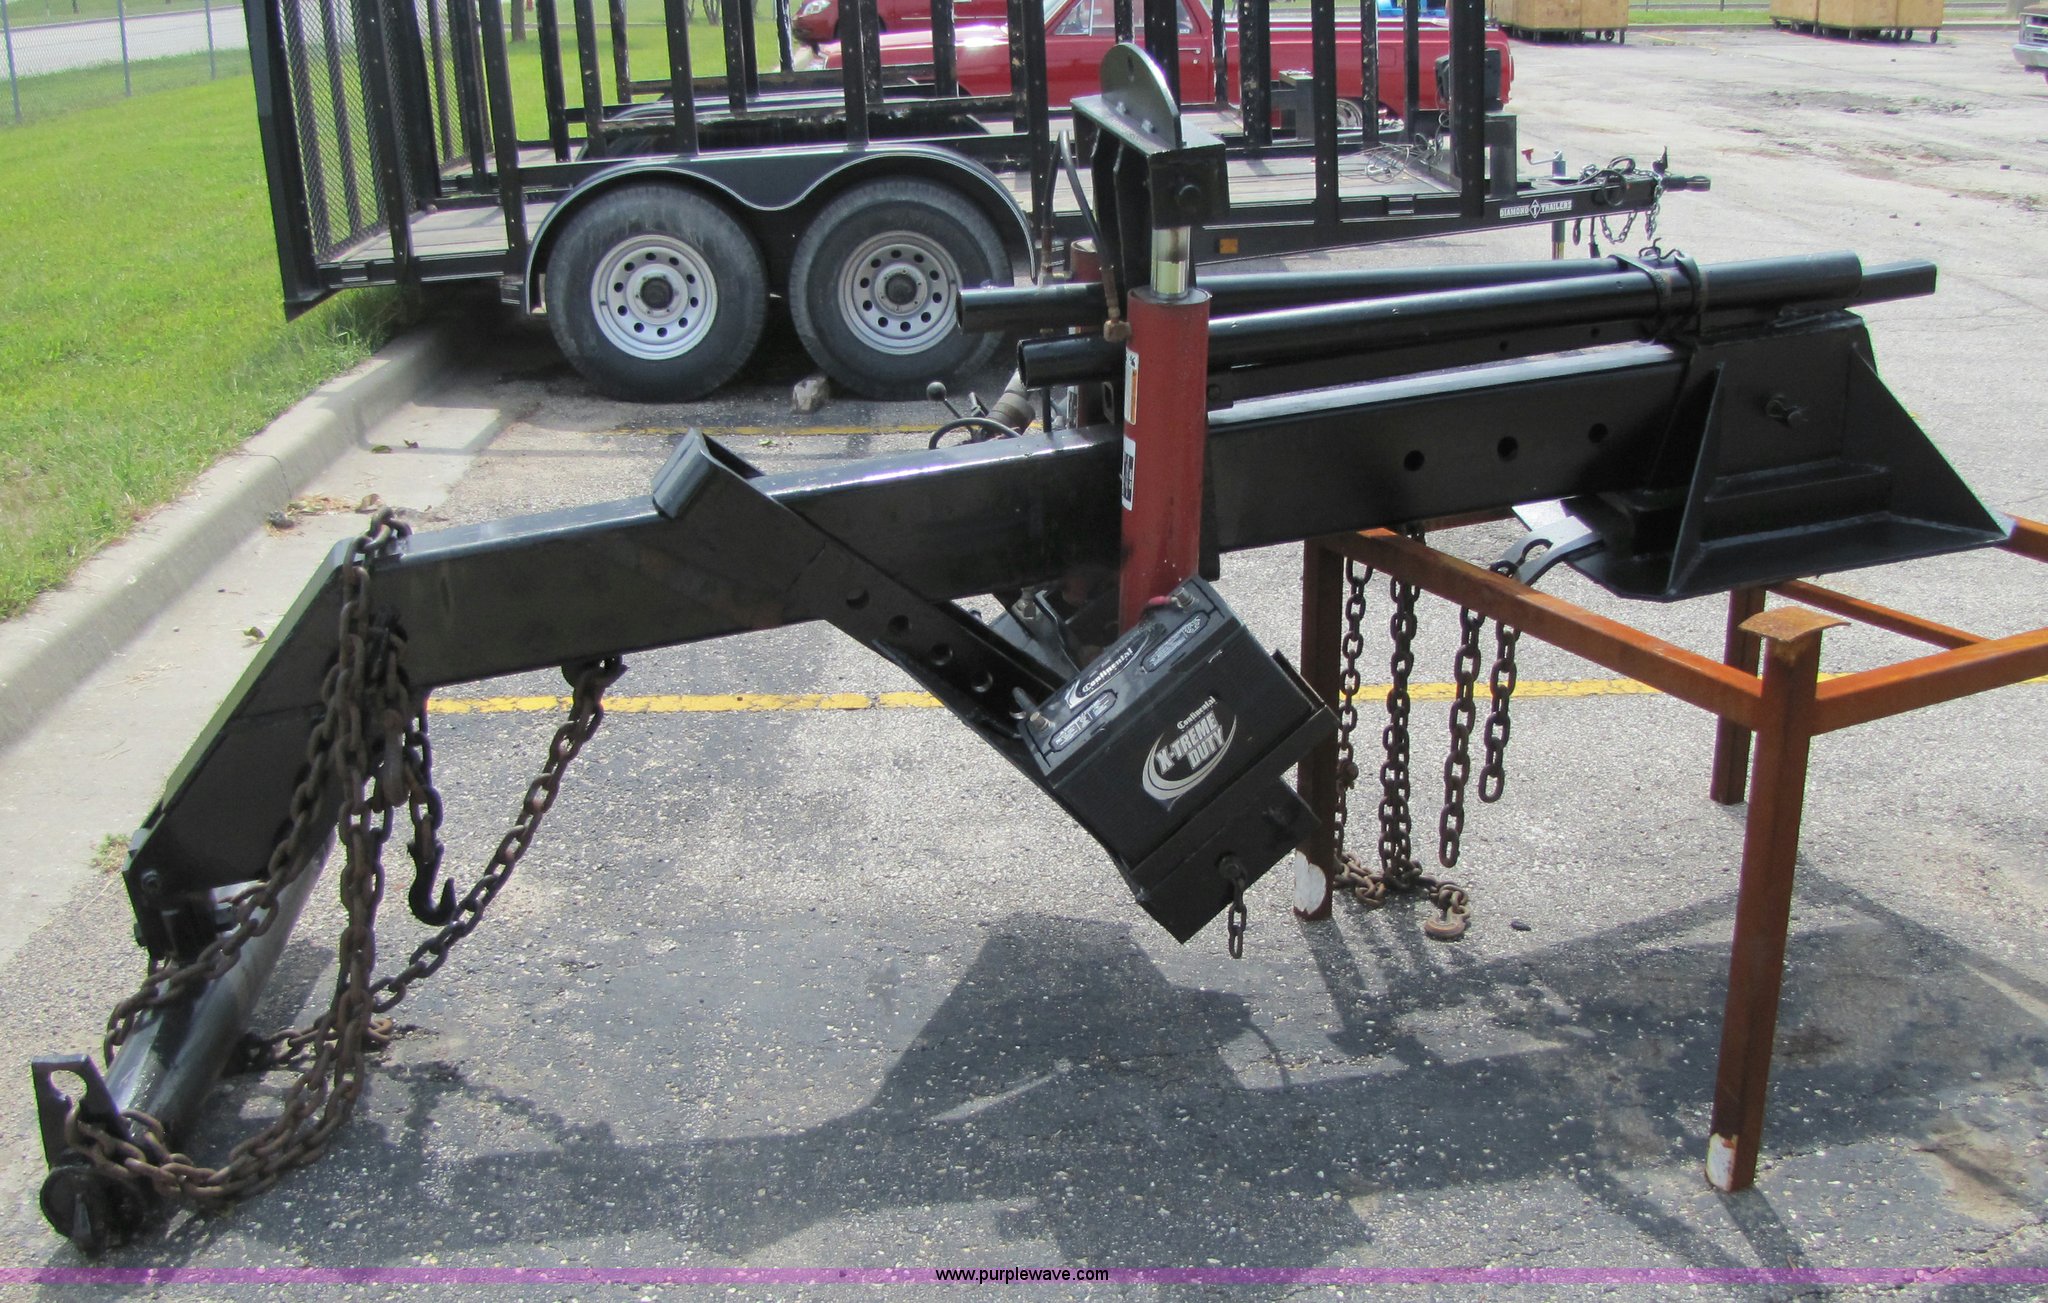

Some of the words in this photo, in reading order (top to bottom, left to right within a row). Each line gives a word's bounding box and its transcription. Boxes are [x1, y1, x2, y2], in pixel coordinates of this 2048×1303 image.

[1500, 204, 1530, 218] DIAMOND
[1540, 200, 1572, 213] TRAILERS
[1082, 647, 1134, 693] Continental
[1176, 695, 1217, 731] Continental
[1155, 710, 1220, 775] X-TREME
[1187, 724, 1226, 770] DUTY
